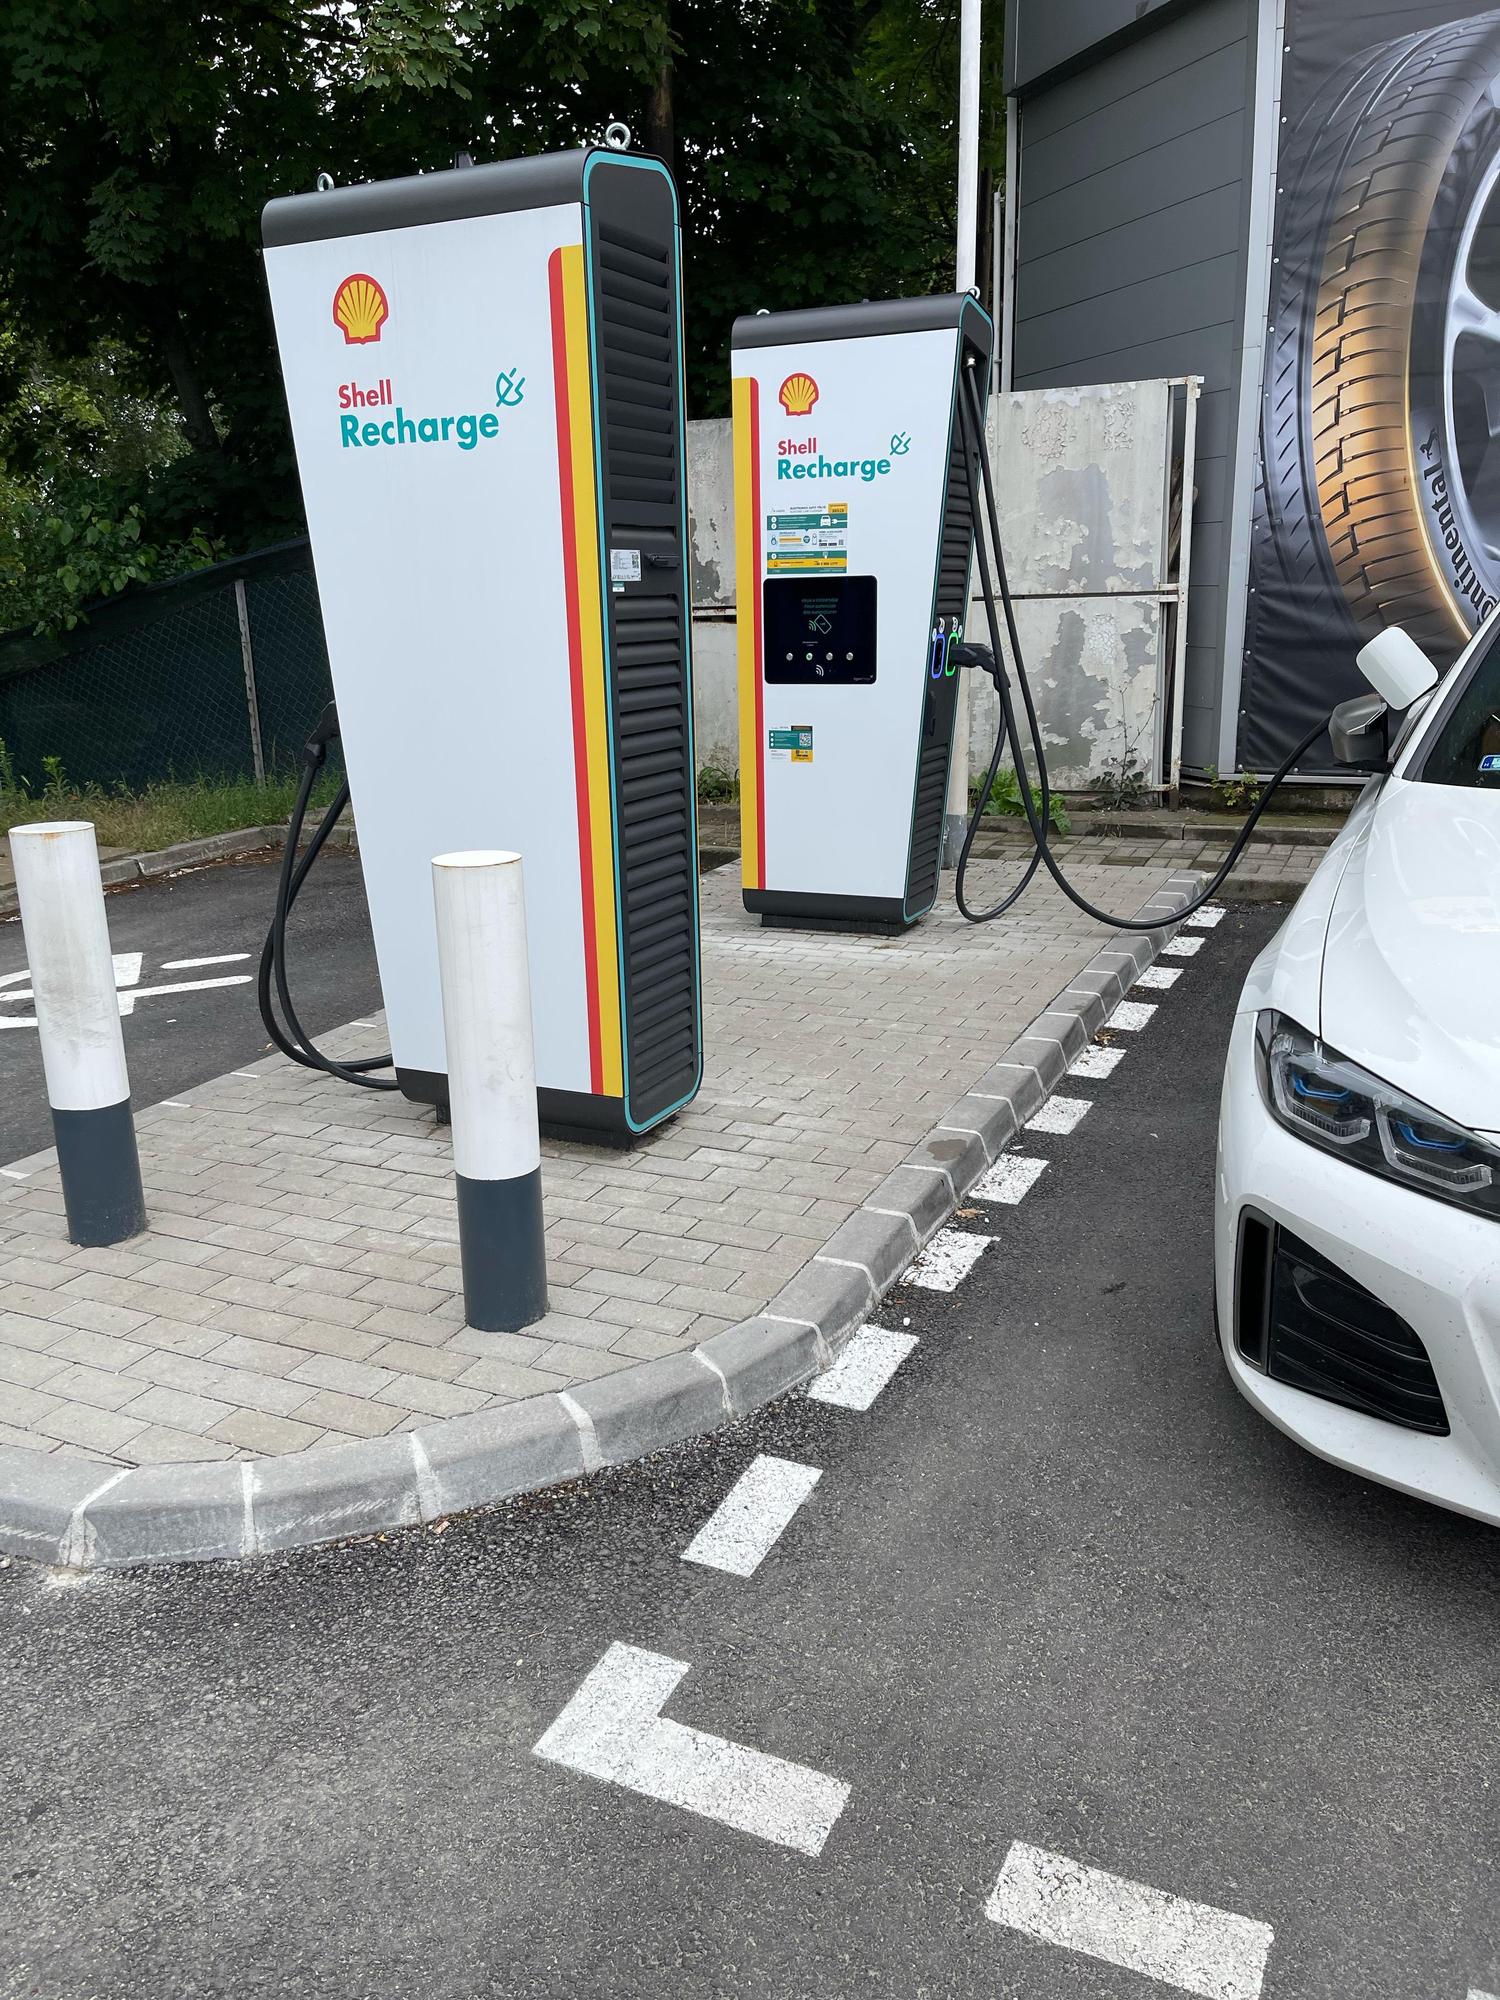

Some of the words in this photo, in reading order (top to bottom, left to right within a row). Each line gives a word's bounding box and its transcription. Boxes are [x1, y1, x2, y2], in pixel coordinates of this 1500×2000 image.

[338, 379, 392, 409] Shell
[340, 407, 499, 450] Recharge
[778, 437, 817, 455] Shell
[777, 455, 891, 482] Recharge
